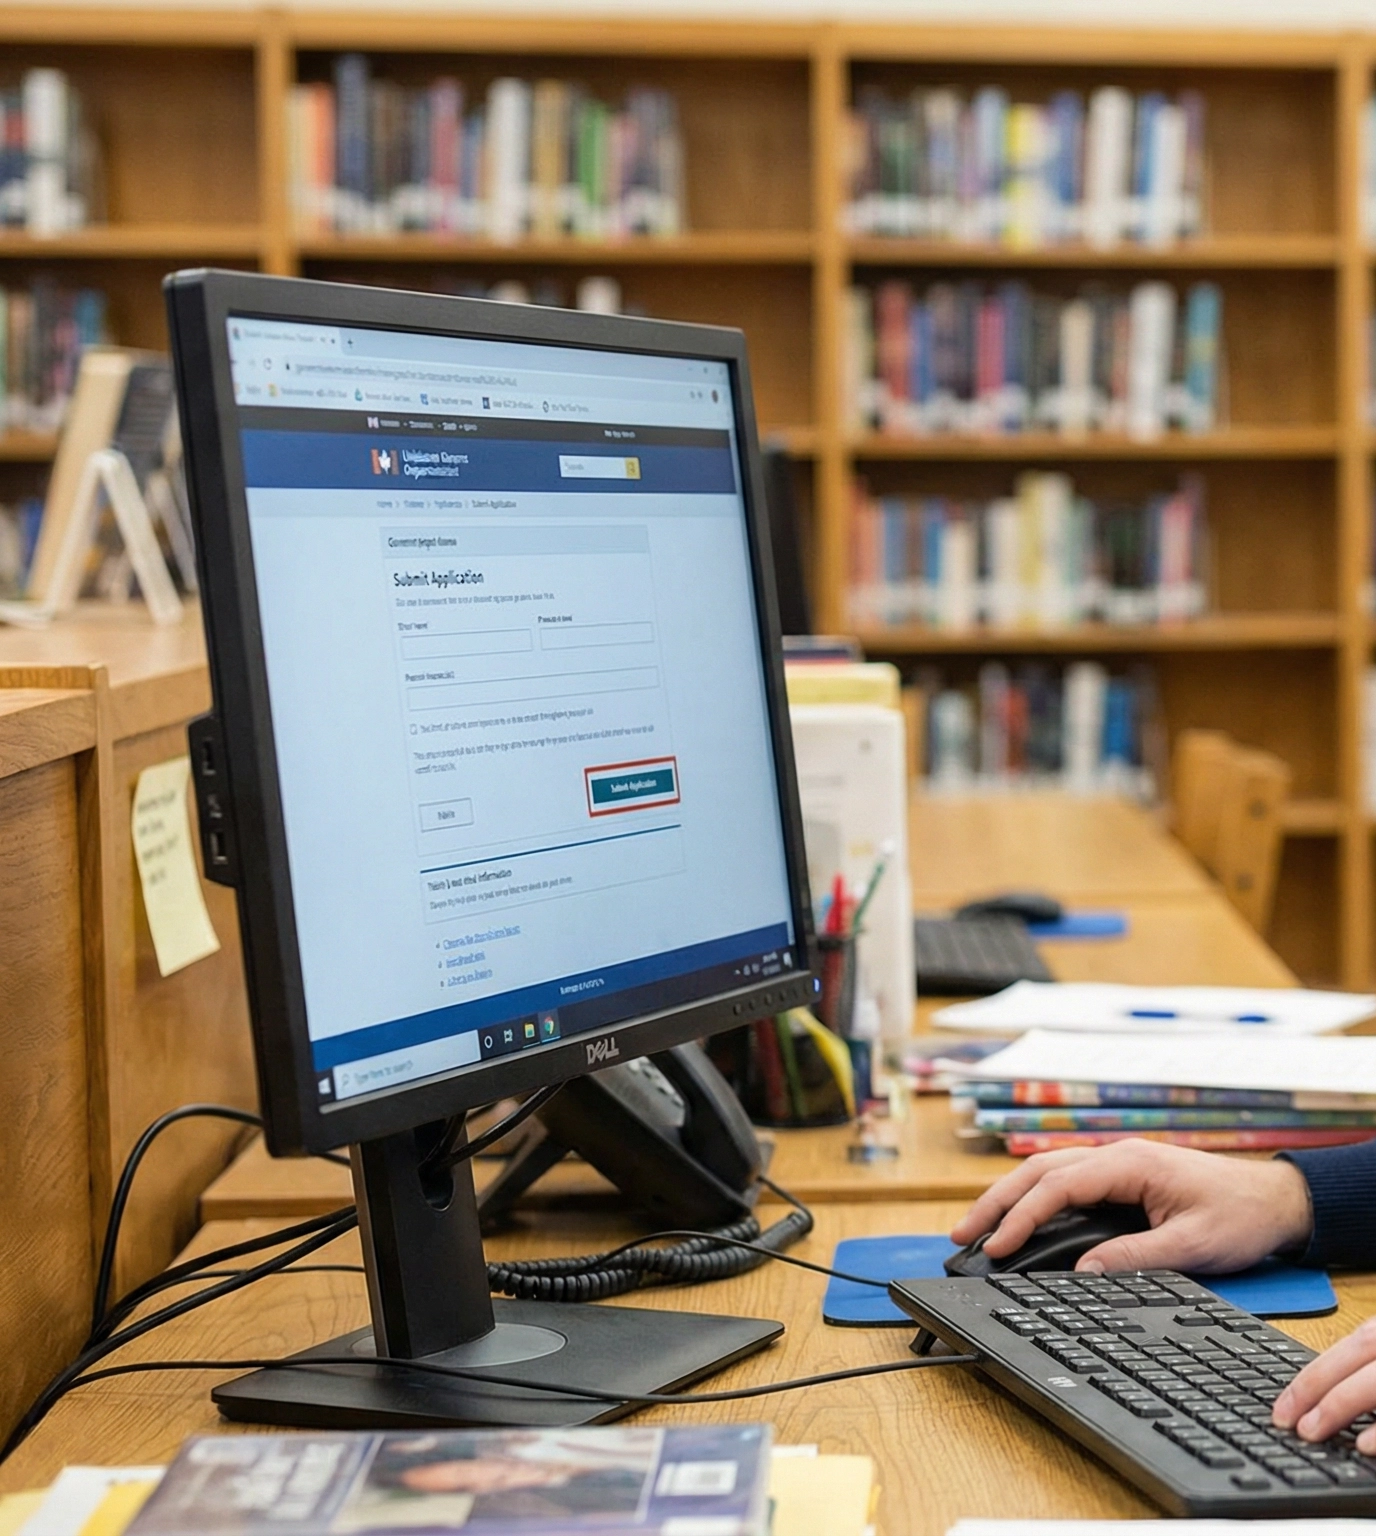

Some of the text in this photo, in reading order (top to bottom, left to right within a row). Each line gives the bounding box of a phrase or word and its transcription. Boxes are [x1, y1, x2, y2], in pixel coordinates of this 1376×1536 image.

[393, 569, 484, 588] Submit Application
[586, 1036, 620, 1065] DELL
